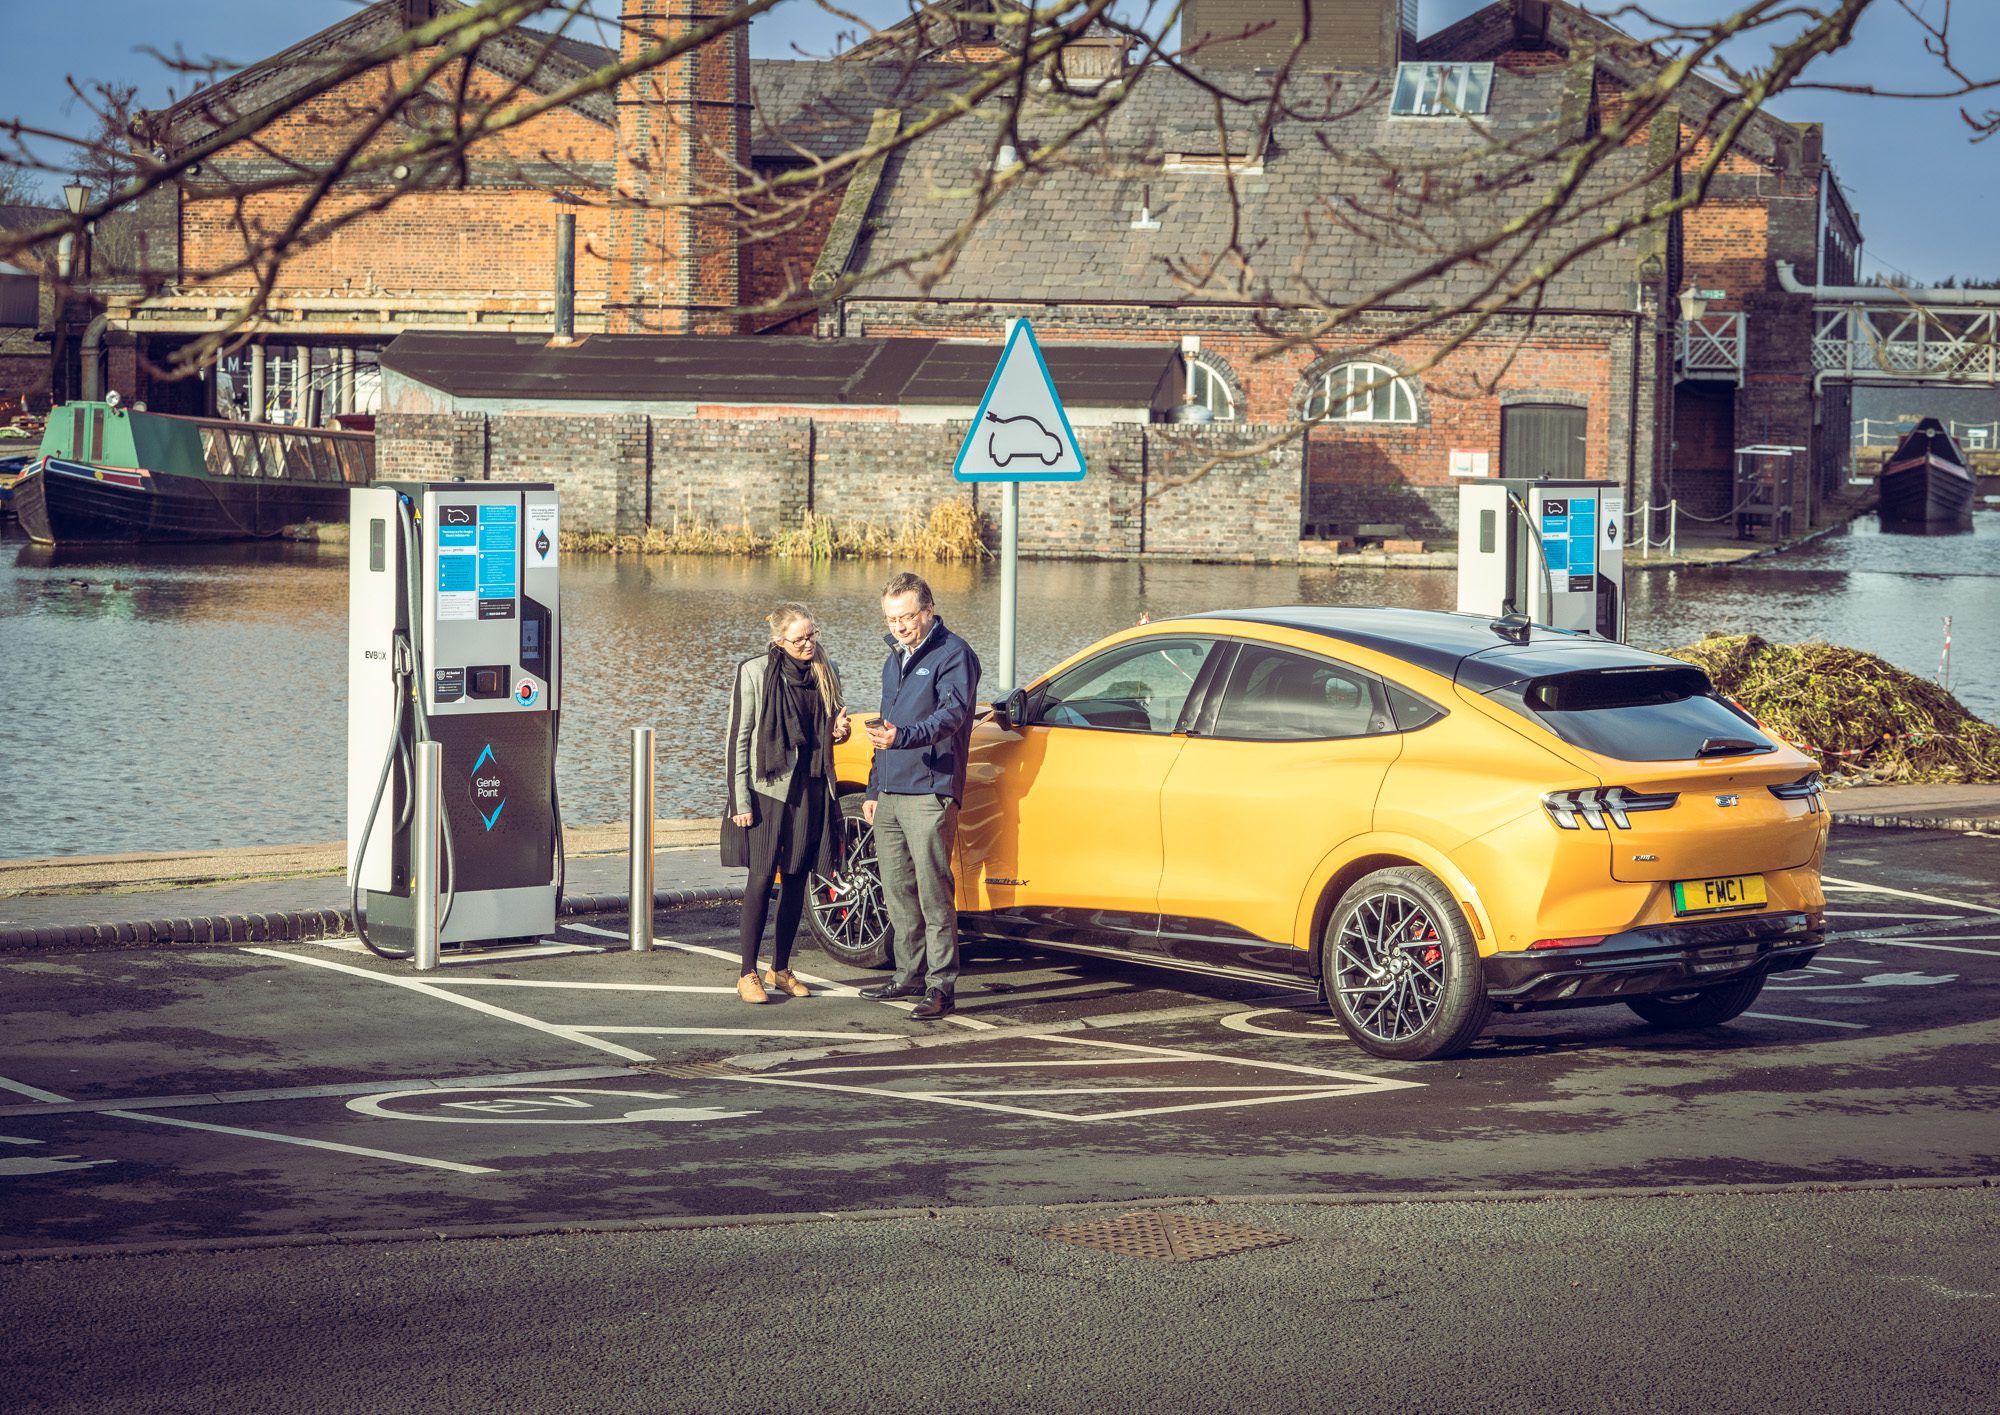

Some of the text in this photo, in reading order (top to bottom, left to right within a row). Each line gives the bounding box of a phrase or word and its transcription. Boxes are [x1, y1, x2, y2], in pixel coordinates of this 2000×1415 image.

[365, 650, 387, 660] EVBOX
[476, 776, 500, 787] Genie
[477, 788, 498, 797] Point
[440, 1095, 594, 1114] EV
